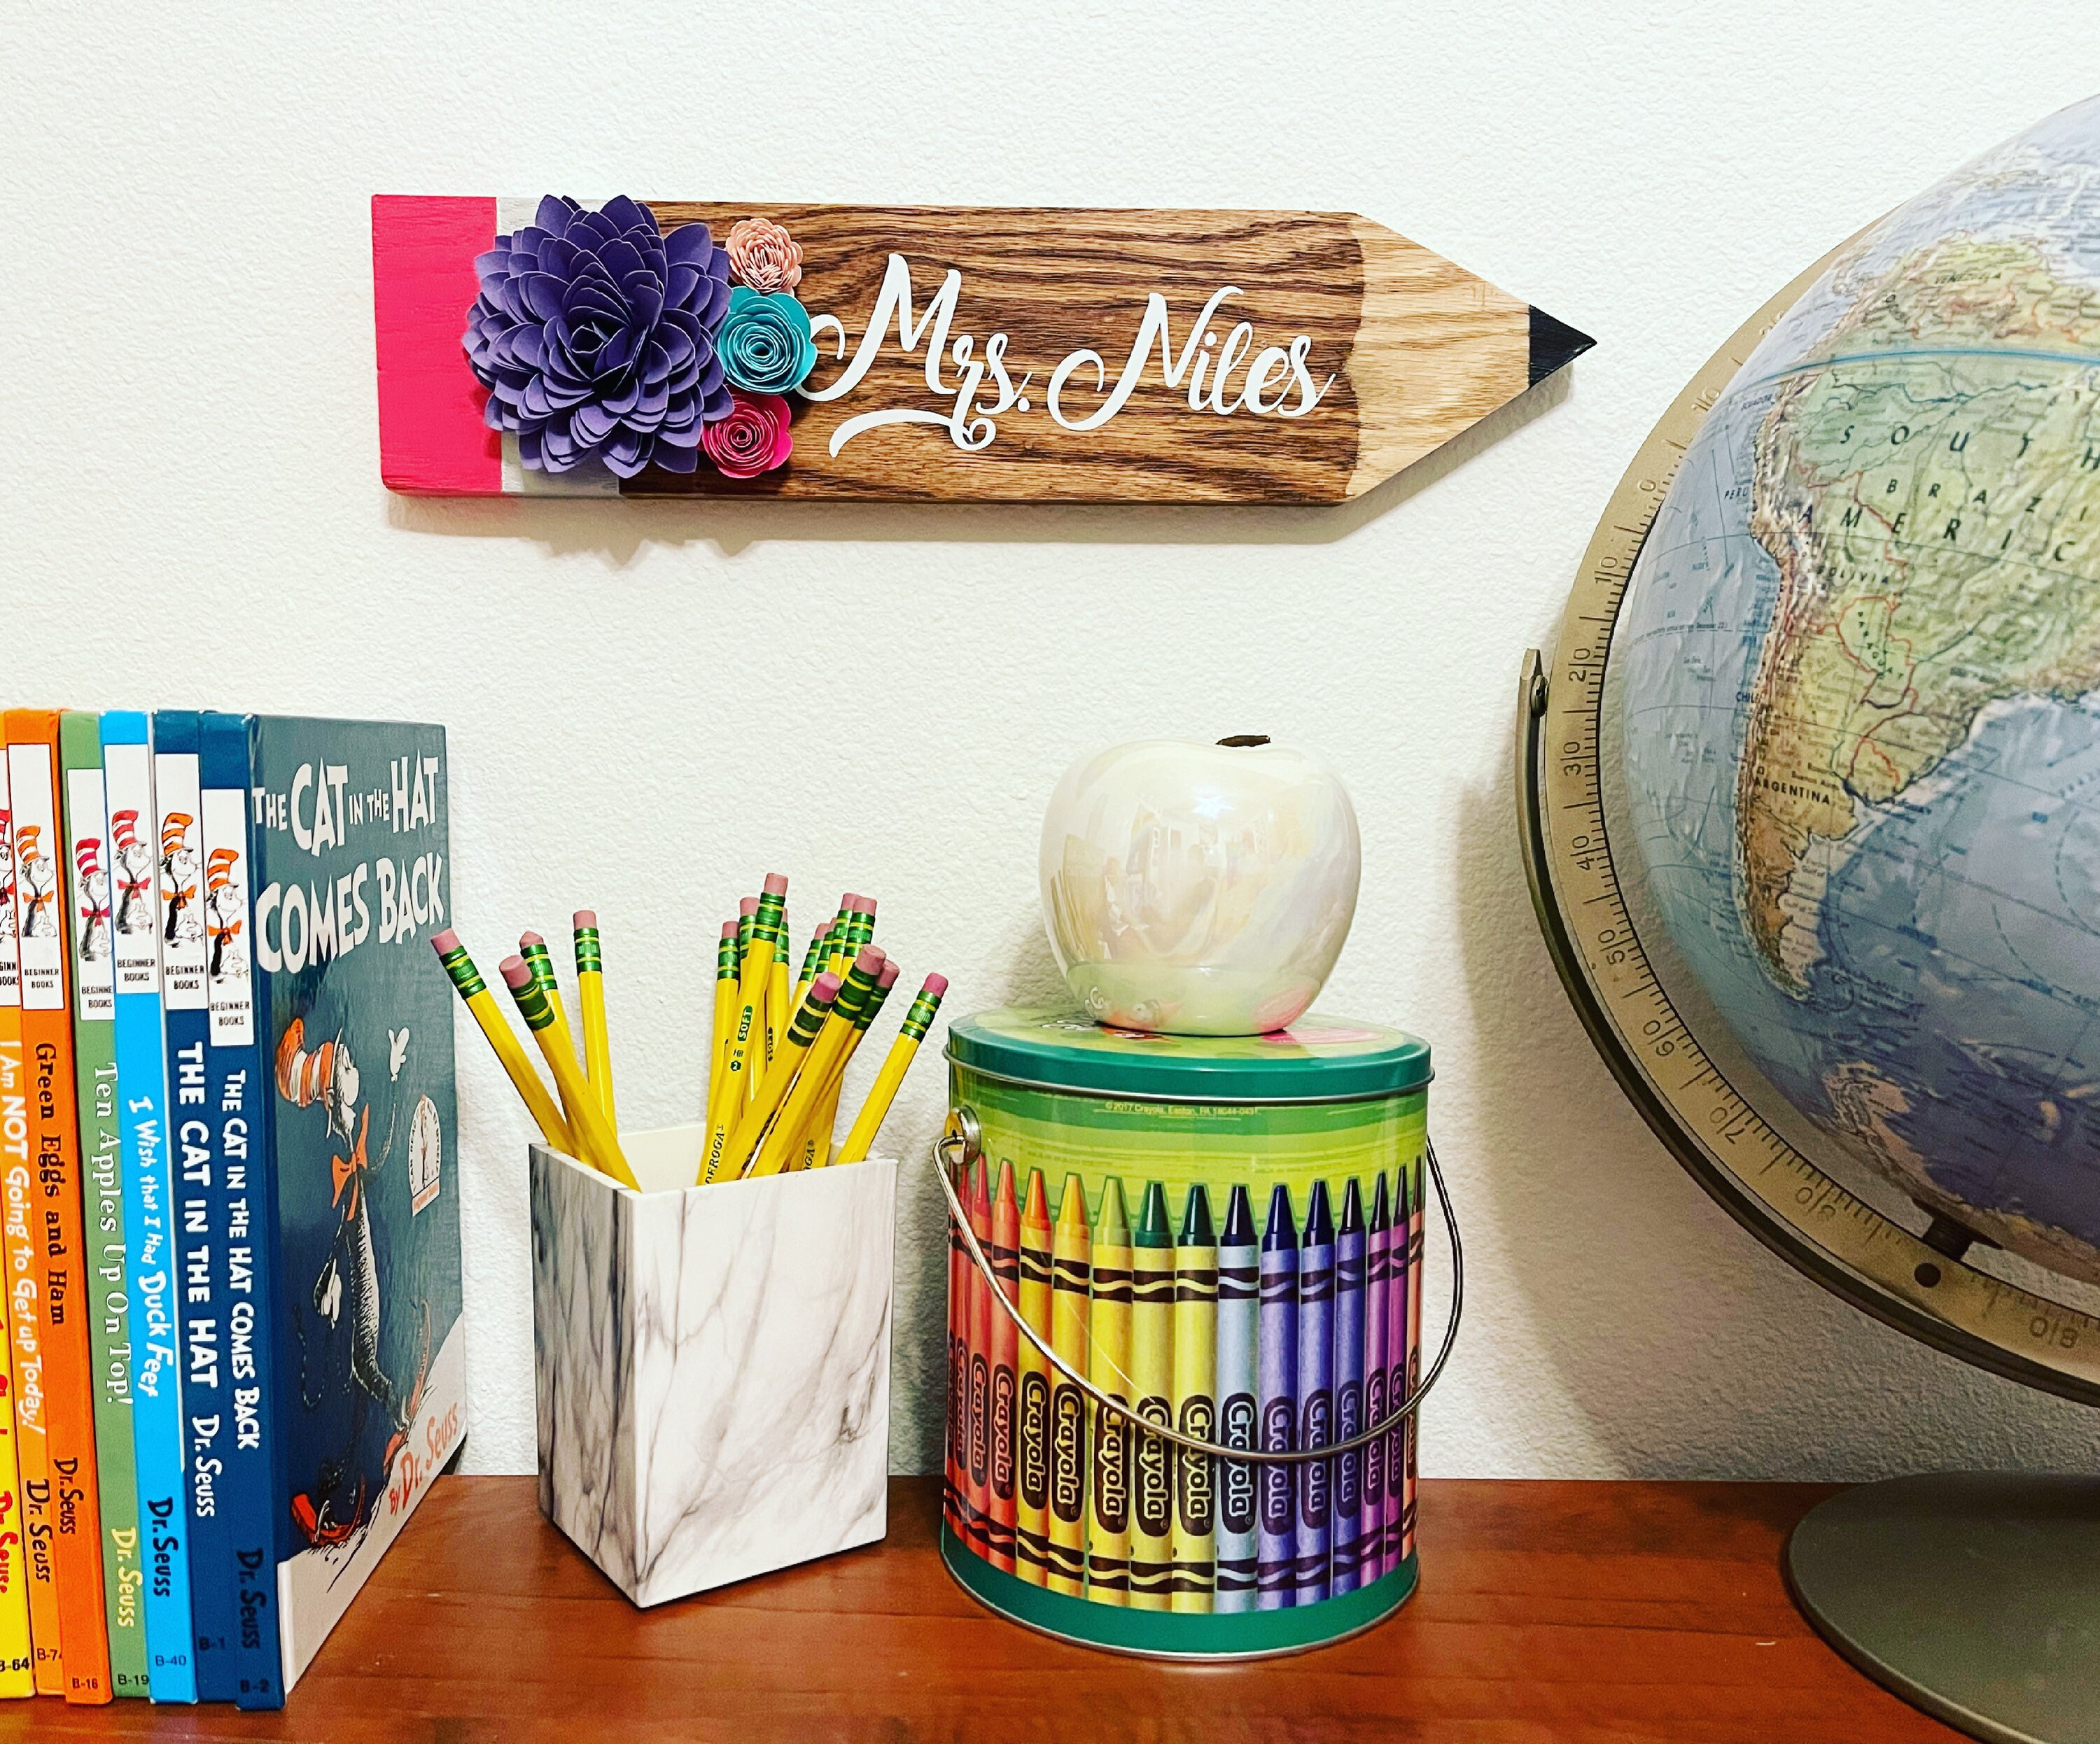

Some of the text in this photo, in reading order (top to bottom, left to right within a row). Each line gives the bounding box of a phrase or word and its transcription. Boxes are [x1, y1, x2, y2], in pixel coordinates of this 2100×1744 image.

[796, 253, 1335, 458] Mrs. Niles
[1569, 647, 1591, 682] 20
[1563, 740, 1581, 777] 30
[251, 748, 439, 857] THE CAT IN THE HAT
[1754, 777, 1830, 806] ARGENTINA
[1572, 835, 1595, 871] 40
[255, 852, 444, 974] COMES BACK
[117, 959, 155, 968] BEGINNER
[1597, 929, 1625, 966] 50
[124, 973, 150, 981] BOOKS
[165, 965, 204, 976] BEGINNER
[174, 980, 199, 990] BOOKS
[88, 999, 113, 1008] BOOKS
[211, 1001, 250, 1011] BEGINNER
[218, 1015, 244, 1026] BOOKS
[738, 1008, 752, 1039] SOFT
[1642, 1019, 1675, 1058] 60
[0, 1055, 22, 1088] Am
[2, 1095, 29, 1161] NOT
[1709, 1106, 1746, 1146] 70
[5, 1165, 31, 1240] Going
[35, 1042, 68, 1326] Green Eggs and Ham
[91, 1062, 134, 1405] Ten Apples Up On Top!
[128, 1096, 174, 1398] I Wish that I Had Duck Feet
[13, 1244, 34, 1272] to
[178, 1041, 223, 1517] THE CAT IN THE HAT Dr. Seuss
[222, 1069, 260, 1449] THE CAT IN THE HAT COMES BACK
[13, 1278, 37, 1323] Get
[15, 1325, 38, 1353] up
[18, 1355, 46, 1435] Today!
[972, 1362, 986, 1470] Crayola
[993, 1371, 1014, 1483] Crayola
[1023, 1380, 1046, 1492] Crayola
[1054, 1391, 1081, 1505] Crayola
[400, 1451, 424, 1512] Dr.
[425, 1402, 458, 1471] Seuss
[53, 1456, 85, 1535] Dr. Seuss
[27, 1478, 54, 1584] Dr. Seuss
[147, 1496, 179, 1598] Dr. Seuss
[111, 1526, 143, 1628] Dr. Seuss
[236, 1547, 267, 1650] Dr. Seuss
[72, 1676, 99, 1690] B-16
[118, 1673, 150, 1686] B-19
[155, 1655, 187, 1667] B-40
